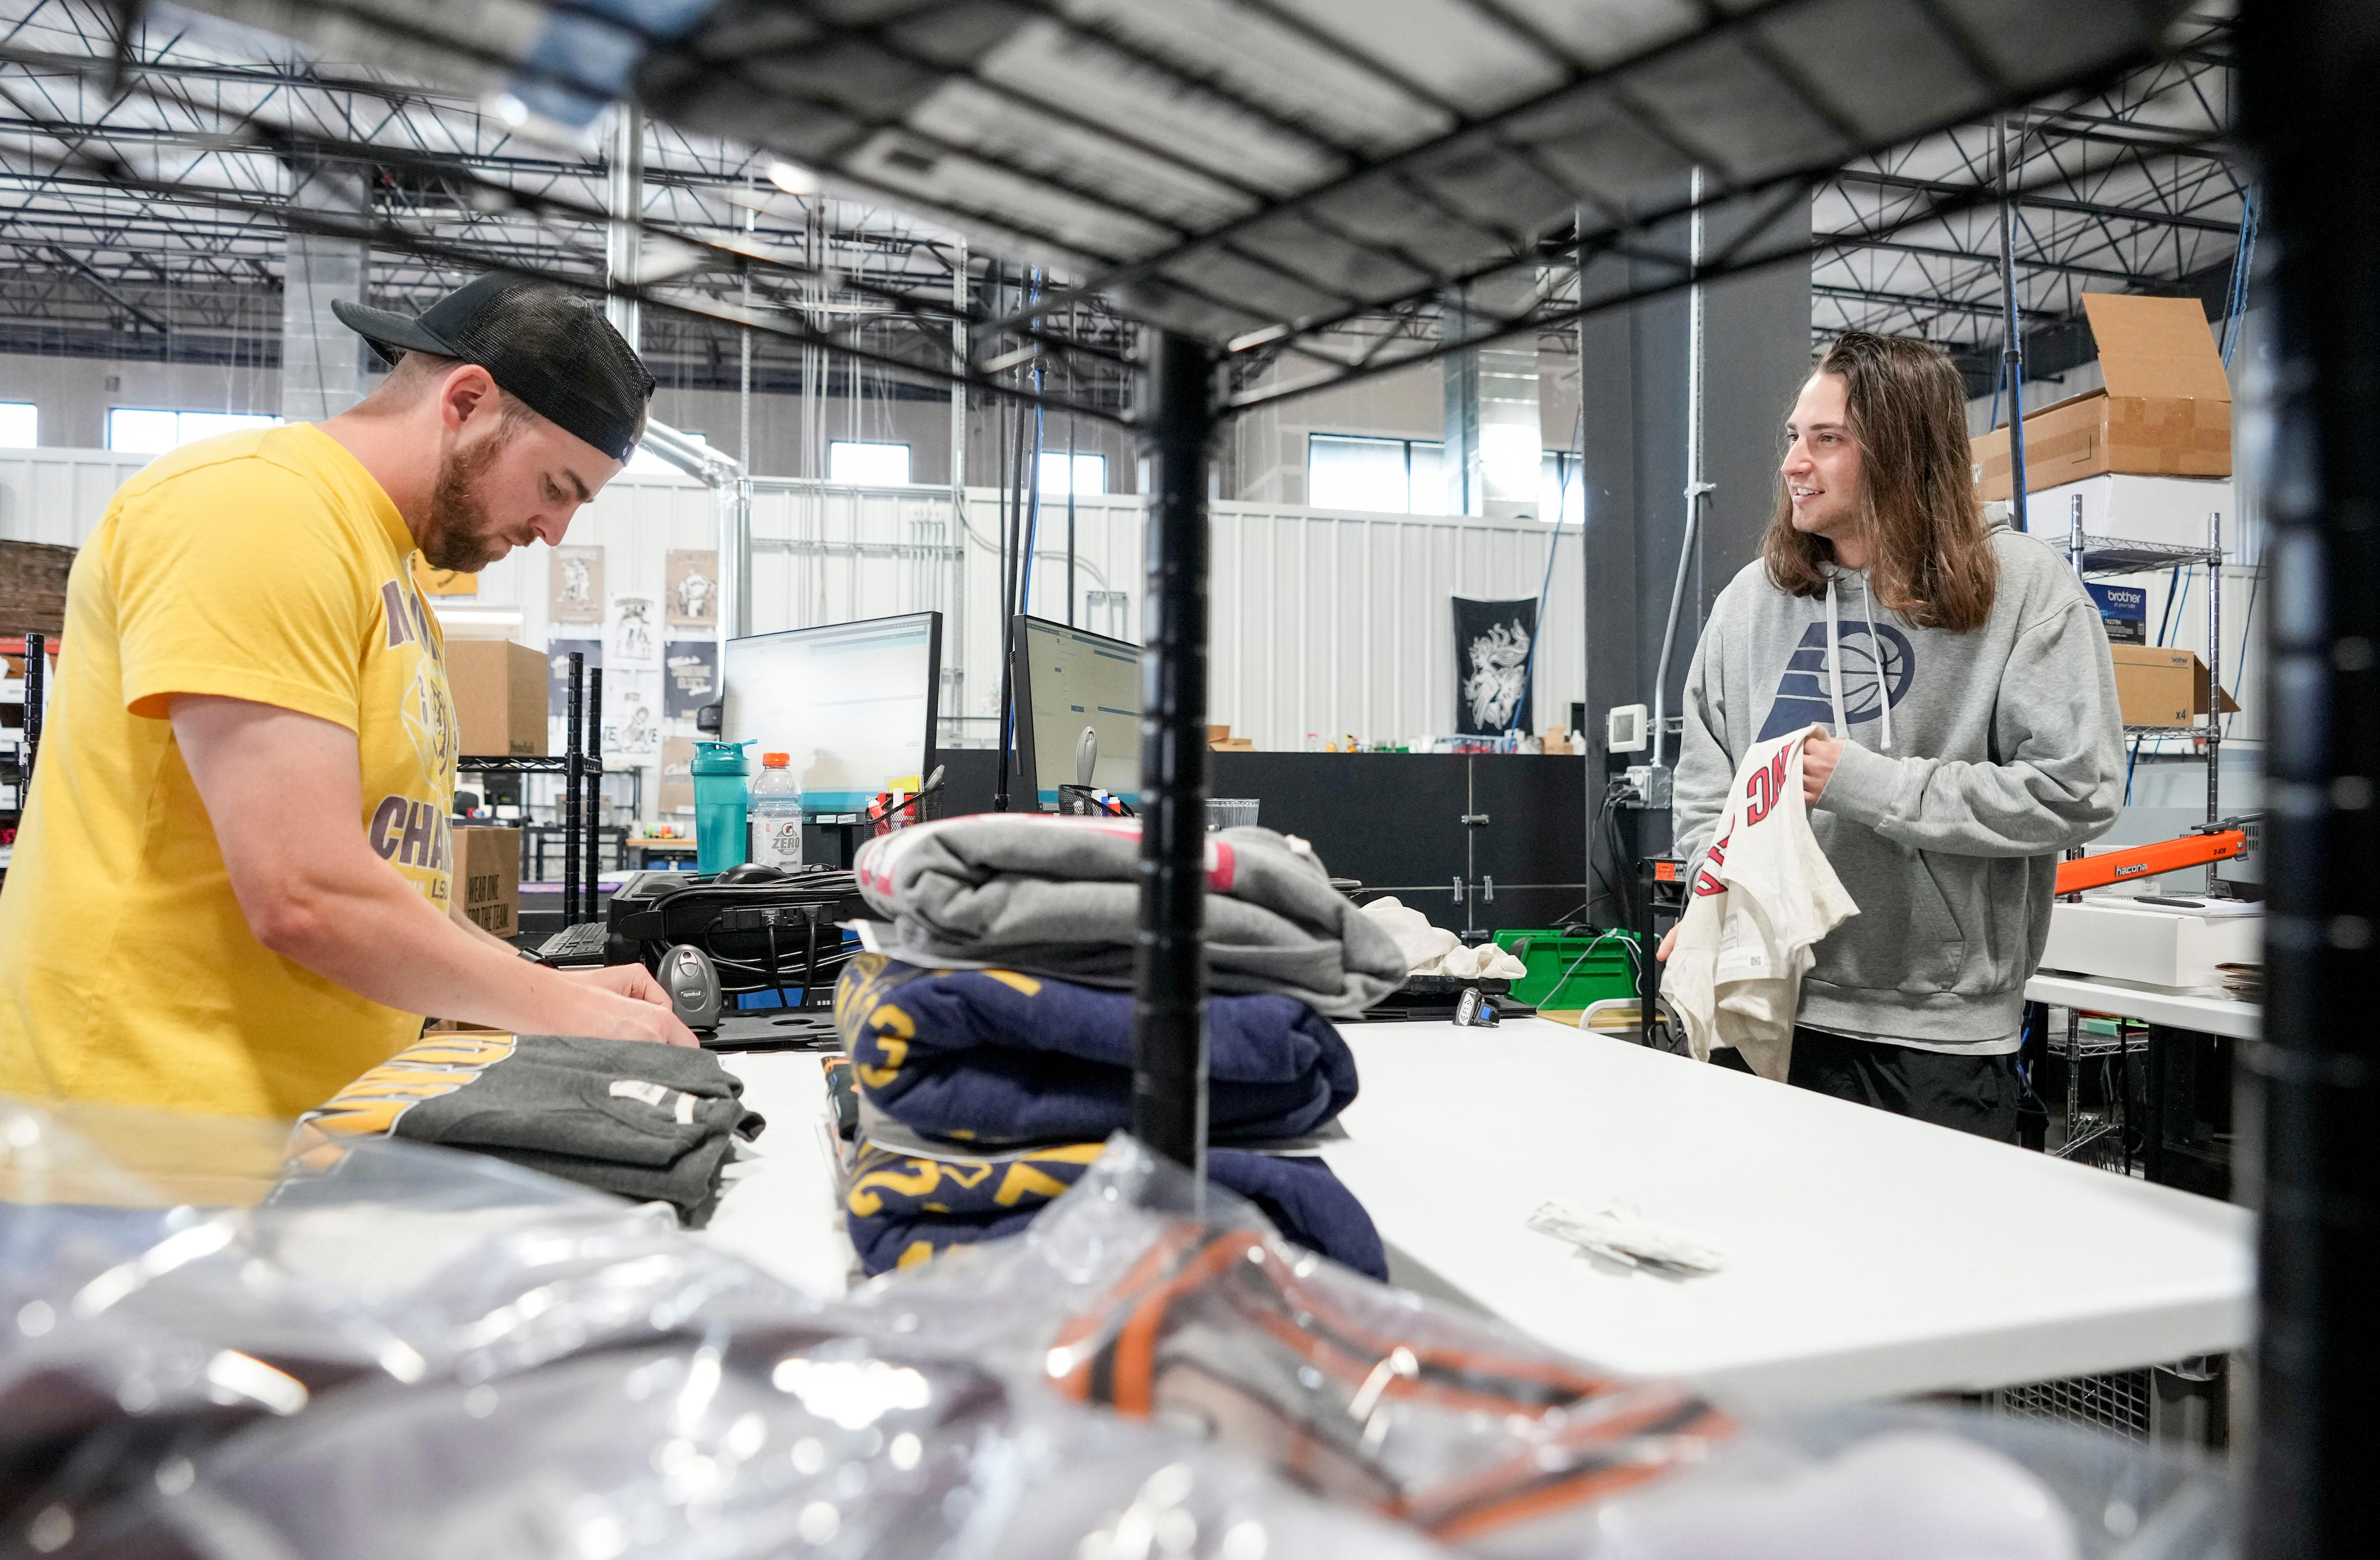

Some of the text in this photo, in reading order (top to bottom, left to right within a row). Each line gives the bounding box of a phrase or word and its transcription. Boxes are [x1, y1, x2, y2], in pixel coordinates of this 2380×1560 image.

[2107, 590, 2141, 604] brother
[2175, 709, 2186, 720] x4
[368, 794, 453, 875] CHA
[771, 837, 800, 849] ZERO
[2115, 863, 2148, 877] hacona
[468, 874, 499, 904] WEAR ONE
